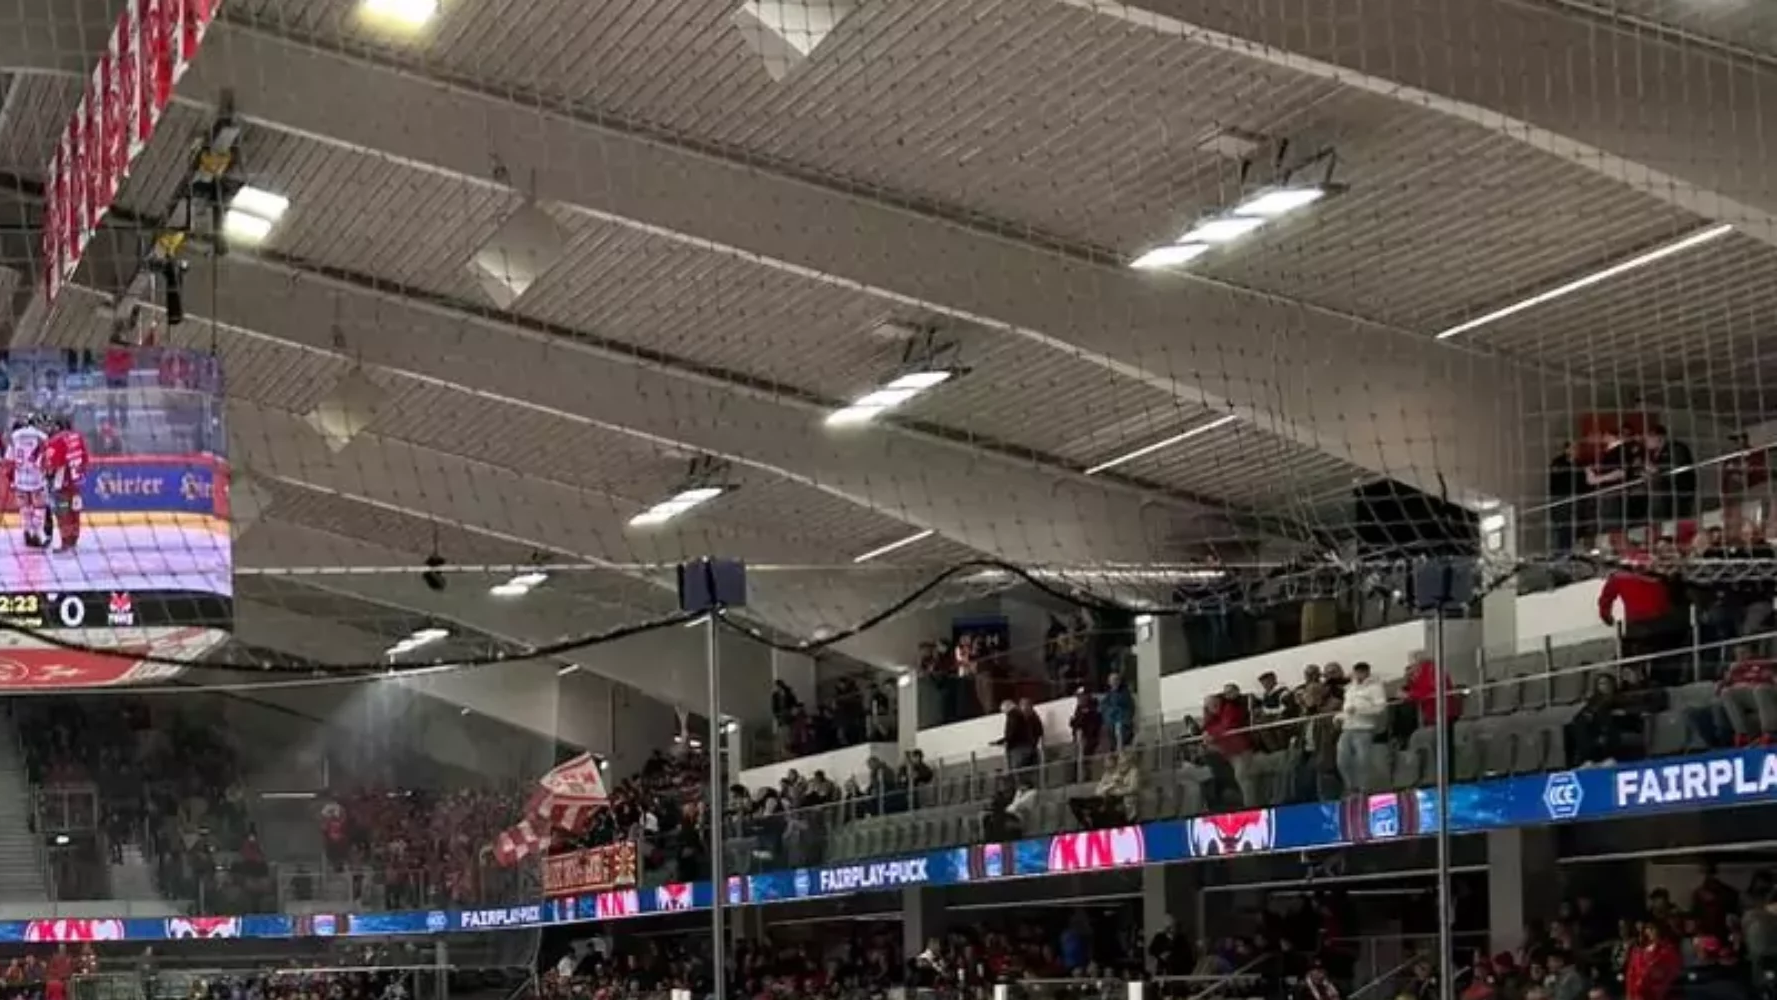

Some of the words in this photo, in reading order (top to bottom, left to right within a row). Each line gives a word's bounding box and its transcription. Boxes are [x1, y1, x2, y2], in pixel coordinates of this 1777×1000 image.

[60, 596, 84, 627] 0
[820, 857, 929, 893] FAIRPLAY-PUCK
[461, 904, 540, 928] FAIRPLAY-PUCK
